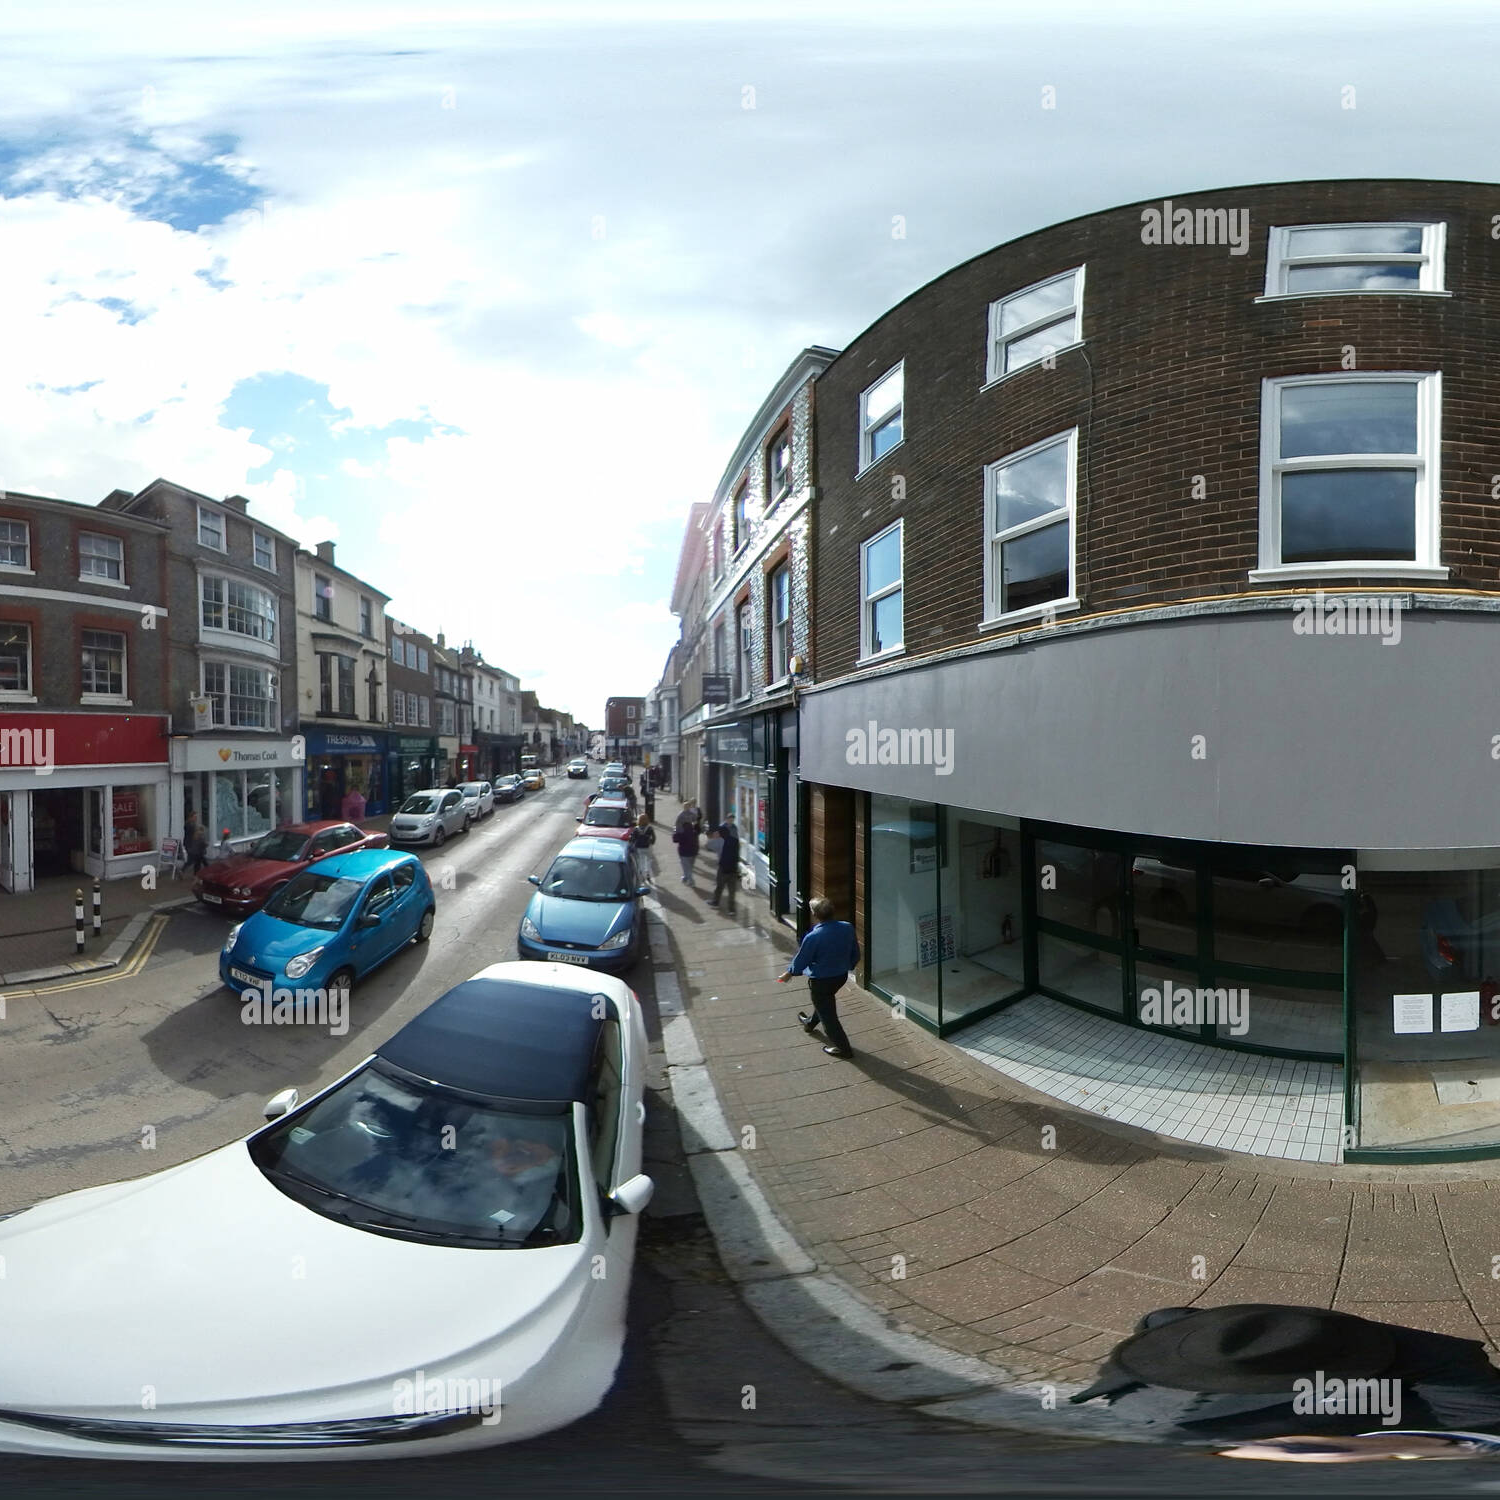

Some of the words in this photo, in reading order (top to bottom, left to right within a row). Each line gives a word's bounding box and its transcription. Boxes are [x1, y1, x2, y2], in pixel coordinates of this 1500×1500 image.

[325, 734, 360, 745] TRESPASS
[234, 751, 261, 761] Thomas
[262, 751, 278, 760] Cook
[113, 802, 133, 812] SALE
